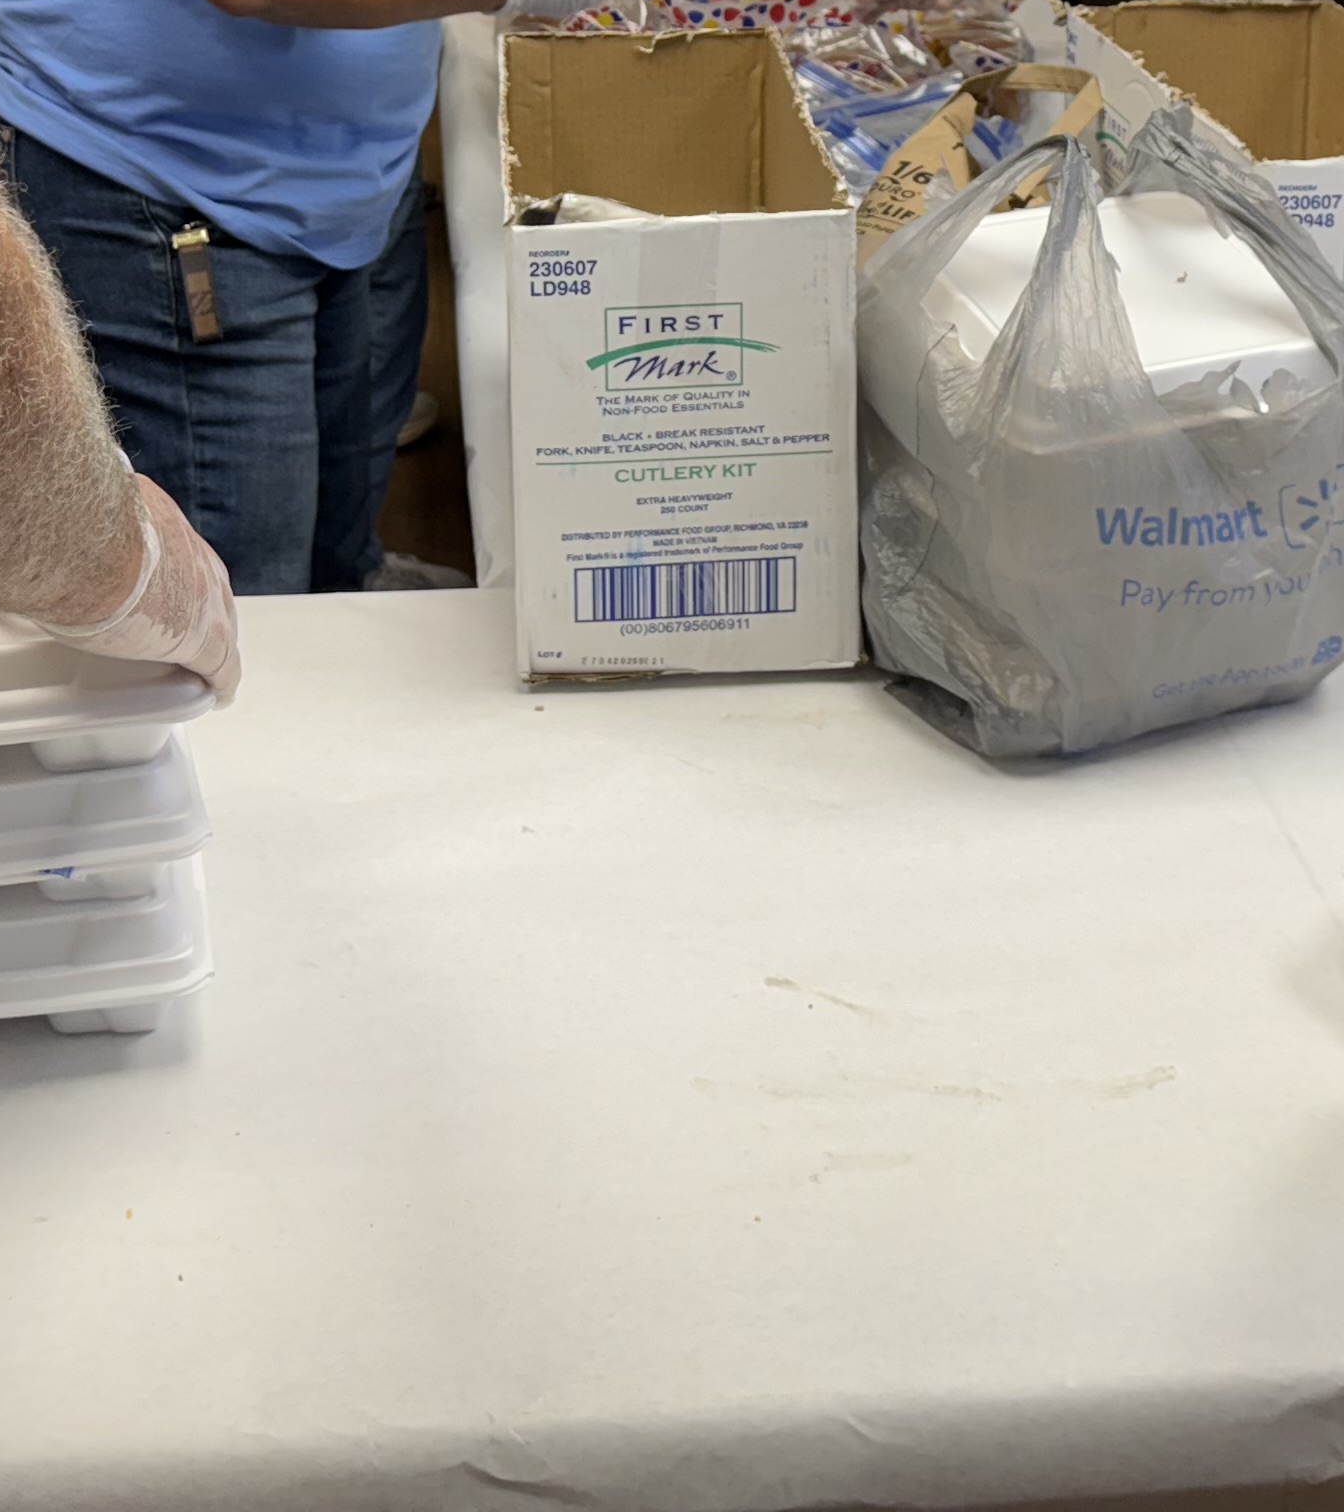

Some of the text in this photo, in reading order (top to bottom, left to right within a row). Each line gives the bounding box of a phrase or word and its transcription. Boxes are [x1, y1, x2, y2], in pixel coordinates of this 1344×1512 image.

[892, 160, 934, 185] 1/6
[1278, 194, 1343, 210] 230607
[529, 260, 598, 277] 230607
[530, 280, 591, 297] LD948
[618, 314, 724, 335] FIRST
[613, 350, 725, 383] Mark
[596, 389, 751, 406] THE MARK OF QUALITY IN
[602, 400, 745, 417] NON-FOOD ESSENTIALS
[602, 425, 766, 443] BLACK BREAK RESISTANT
[536, 433, 831, 457] FORK, KNIFE, TEASPOON, NAPKIN, SALT & PEPPER
[614, 462, 758, 483] CUTLERY KIT
[636, 492, 733, 506] EXTRA HEAVYWEIGHT
[677, 503, 709, 513] COUNT
[1095, 500, 1269, 547] Walmart
[561, 531, 611, 542] DISTRIBUTED
[612, 530, 622, 539] BY
[624, 528, 680, 538] PERFORMANCE
[682, 526, 703, 535] FOOD
[652, 538, 674, 547] MADE
[566, 553, 584, 562] First
[760, 542, 779, 551] Food
[1121, 579, 1174, 613] Pay
[1183, 580, 1255, 608] from
[620, 618, 751, 637] (00)806795606911
